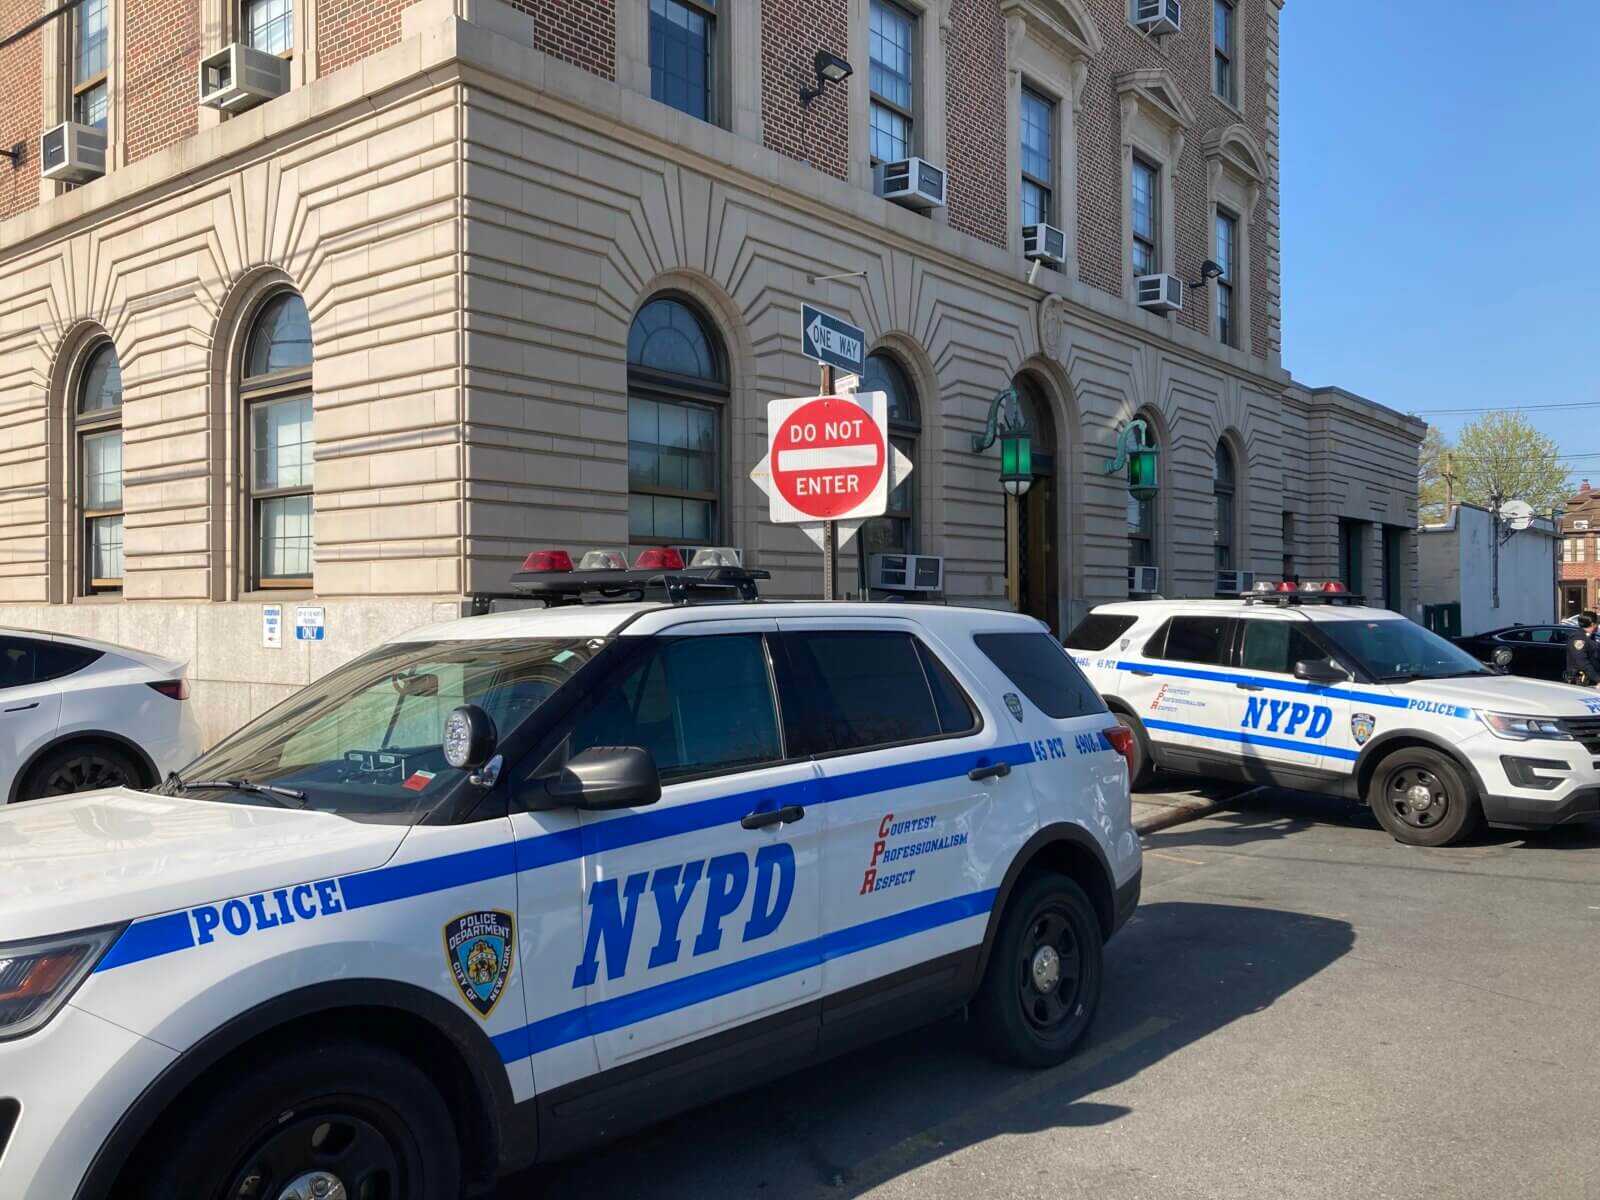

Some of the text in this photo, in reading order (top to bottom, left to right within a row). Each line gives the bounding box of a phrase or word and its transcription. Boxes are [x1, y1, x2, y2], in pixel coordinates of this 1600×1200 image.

[813, 322, 859, 361] ONE WAY
[790, 420, 863, 443] DO NOT
[796, 475, 859, 495] ENTER
[1241, 696, 1332, 739] NYPD
[1409, 699, 1455, 716] POLICE
[1033, 739, 1047, 761] 45
[1046, 737, 1067, 759] PCT
[878, 814, 936, 838] COURTESY
[870, 832, 968, 866] PROFESSIONALISM
[860, 869, 915, 895] RESPECT
[192, 879, 342, 944] POLICE
[459, 913, 497, 930] POLICE
[572, 842, 796, 989] NYPD
[449, 924, 511, 950] DEPARTMENT
[453, 944, 511, 1001] CITY OF NEW YORK
